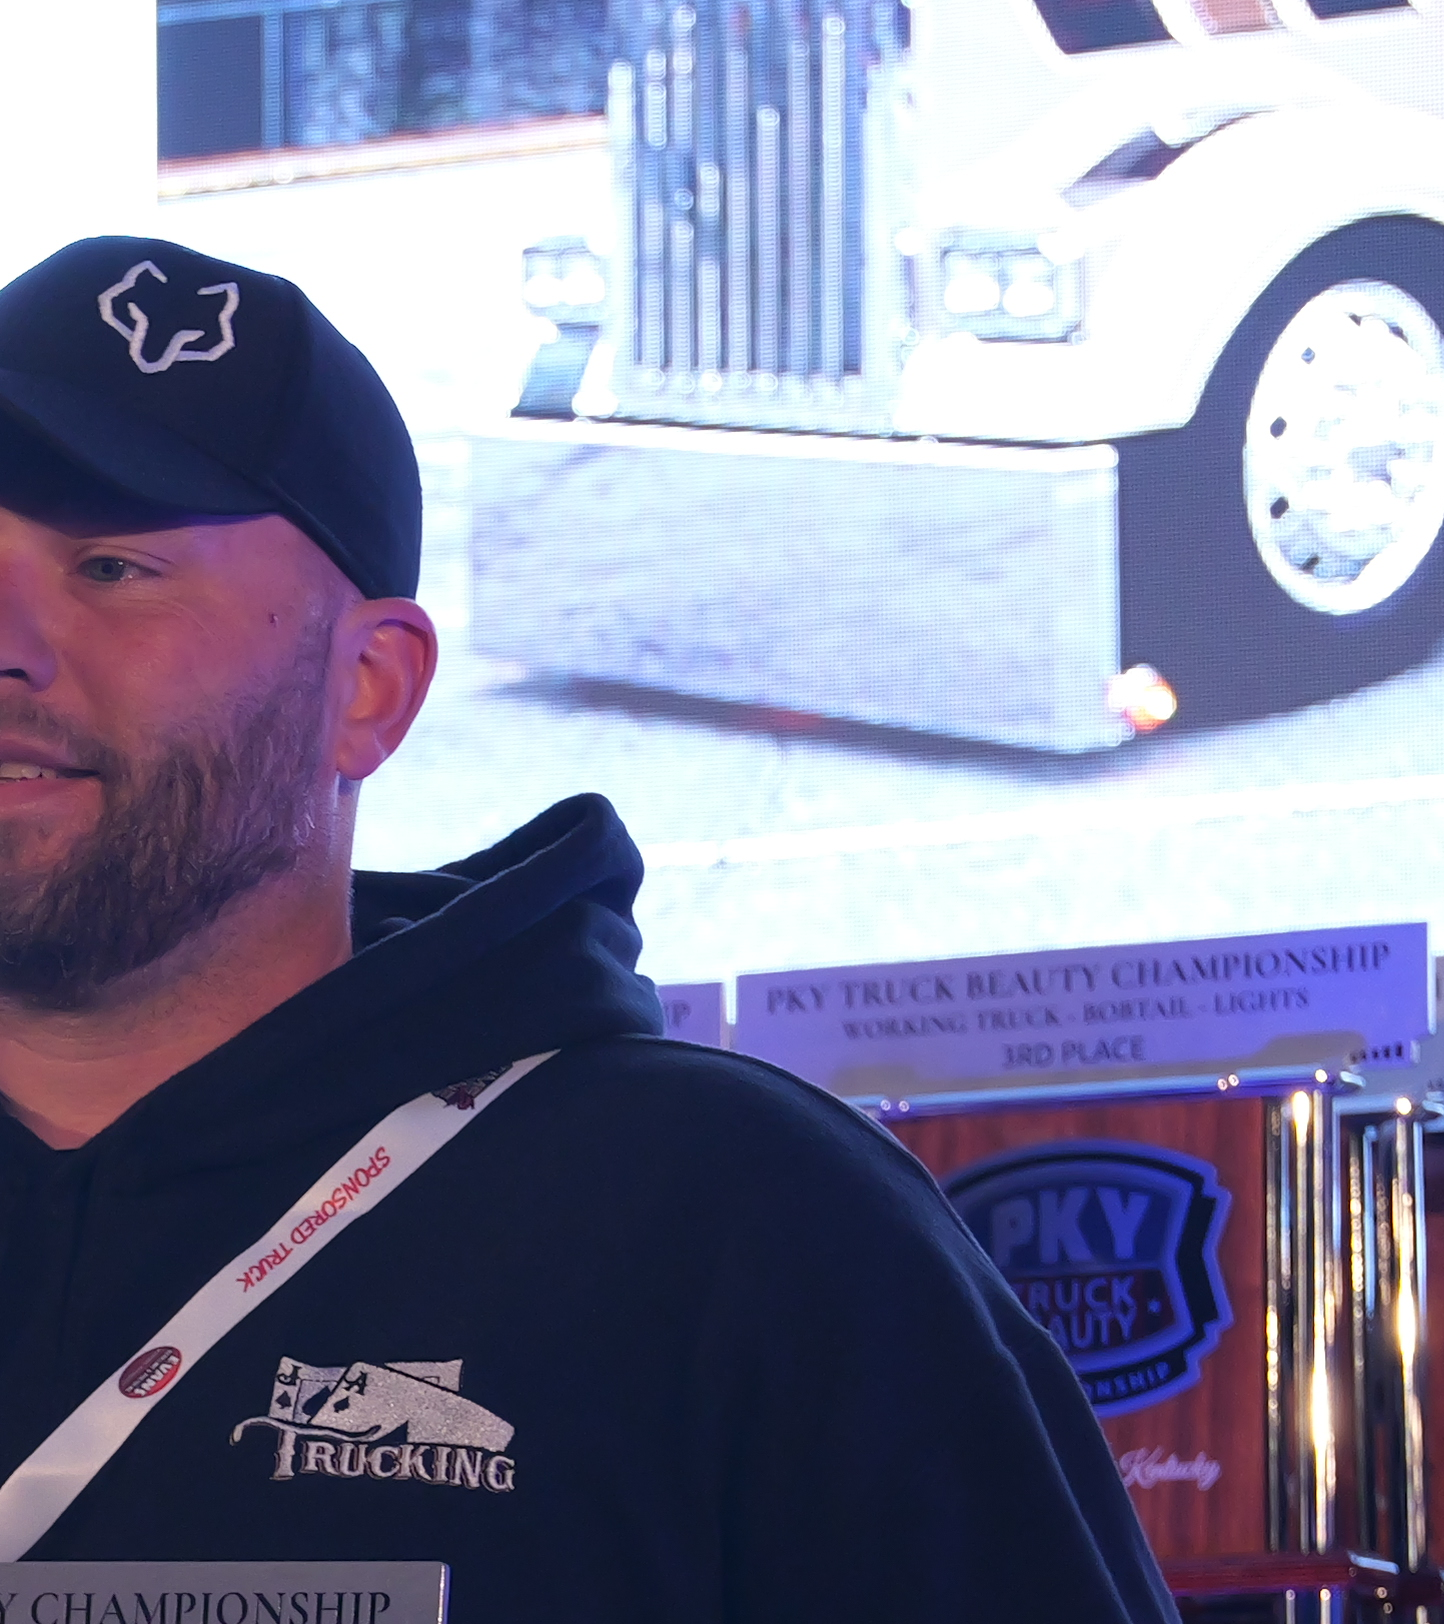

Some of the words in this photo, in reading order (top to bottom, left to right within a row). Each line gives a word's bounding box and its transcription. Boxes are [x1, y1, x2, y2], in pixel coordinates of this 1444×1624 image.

[765, 984, 826, 1015] PKY
[841, 975, 956, 1010] TRUCK
[965, 963, 1101, 1001] BEAUTY
[1110, 942, 1392, 992] CHAMPIONSHIP
[841, 1011, 965, 1040] WORKING
[976, 1005, 1062, 1033] TRUCK
[1081, 993, 1186, 1026] BOBTAIL
[1212, 986, 1311, 1018] LIGHTS
[1001, 1041, 1055, 1070] 3RD
[1063, 1034, 1148, 1066] PLACE
[290, 1146, 391, 1245] SPONSORED
[989, 1185, 1150, 1268] PKY
[235, 1242, 294, 1293] TRUCK
[132, 1355, 180, 1396] EVANS
[228, 1416, 515, 1492] TRUCKING
